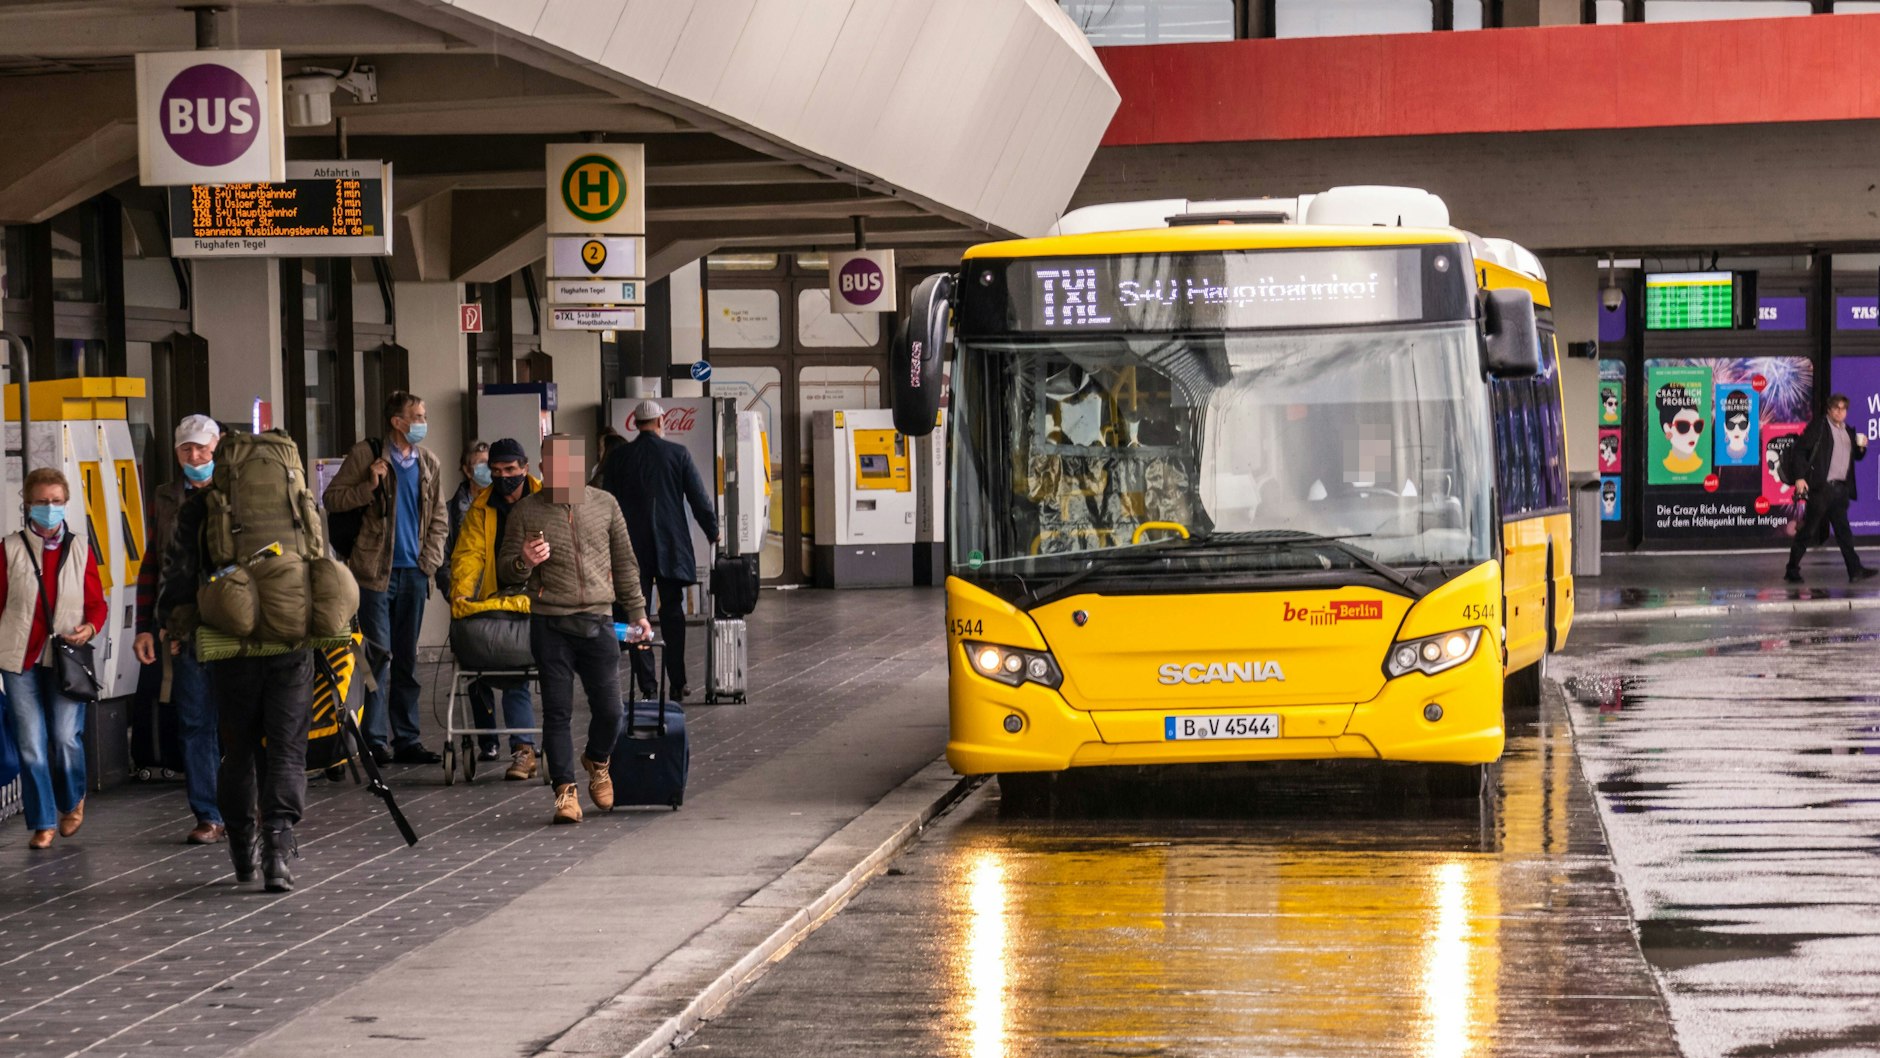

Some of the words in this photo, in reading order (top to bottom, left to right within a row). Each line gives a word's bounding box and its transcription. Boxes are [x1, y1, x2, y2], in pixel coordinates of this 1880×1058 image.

[168, 97, 254, 135] BUS
[314, 168, 349, 177] Abfahrt
[352, 168, 360, 177] in
[336, 179, 342, 189] 2
[343, 179, 360, 189] min
[578, 170, 610, 207] H
[193, 190, 211, 199] TXL
[215, 190, 232, 199] S+U
[234, 189, 297, 199] Hauptbahnhof
[336, 189, 342, 198] 4
[343, 189, 361, 198] min
[192, 199, 211, 208] 128
[215, 199, 221, 208] U
[225, 199, 254, 208] Osloer
[258, 199, 273, 208] Str.
[336, 198, 343, 207] 9
[344, 198, 361, 207] min
[193, 208, 212, 218] TXL
[216, 208, 232, 218] S+U
[235, 207, 298, 218] Hauptbahnhof
[333, 207, 343, 217] 10
[345, 207, 362, 217] min
[193, 217, 212, 227] 128
[216, 217, 223, 227] U
[226, 217, 255, 227] Osloer
[259, 217, 274, 227] Str.
[333, 216, 344, 226] 16
[345, 216, 362, 226] min
[194, 227, 242, 237] spannende
[245, 225, 329, 237] Ausbildungsberufe
[332, 225, 348, 236] bei
[351, 225, 363, 236] de
[194, 240, 240, 251] Flughafen
[243, 239, 267, 250] Tegel
[590, 246, 598, 260] 2
[842, 272, 881, 293] BUS
[560, 287, 589, 295] Flughafen
[590, 287, 606, 295] Tegel
[624, 285, 634, 299] B
[1036, 269, 1112, 326] TXL
[1186, 273, 1378, 308] Hauptbahnhof
[560, 312, 575, 321] TXL
[577, 319, 619, 327] Hauptbahnhof
[1656, 389, 1682, 398] CRAZY
[1683, 388, 1702, 398] RICH
[1662, 397, 1702, 406] PROBLEMS
[1657, 505, 1671, 515] Die
[1672, 504, 1698, 518] Crazy
[1700, 504, 1717, 515] Rich
[1719, 505, 1747, 515] Asians
[741, 513, 749, 543] Tickets
[1657, 517, 1670, 528] auf
[1672, 516, 1690, 528] dem
[1692, 515, 1735, 529] Höhepunkt
[1737, 515, 1755, 526] Ihrer
[1757, 515, 1788, 528] Intrigen
[1283, 601, 1309, 622] be
[1339, 604, 1379, 618] Berlin
[1462, 604, 1495, 621] 4544
[950, 619, 984, 636] 4544
[1157, 659, 1286, 686] SCANIA
[1184, 719, 1196, 736] B
[1208, 718, 1220, 736] V
[1225, 717, 1271, 736] 4544
